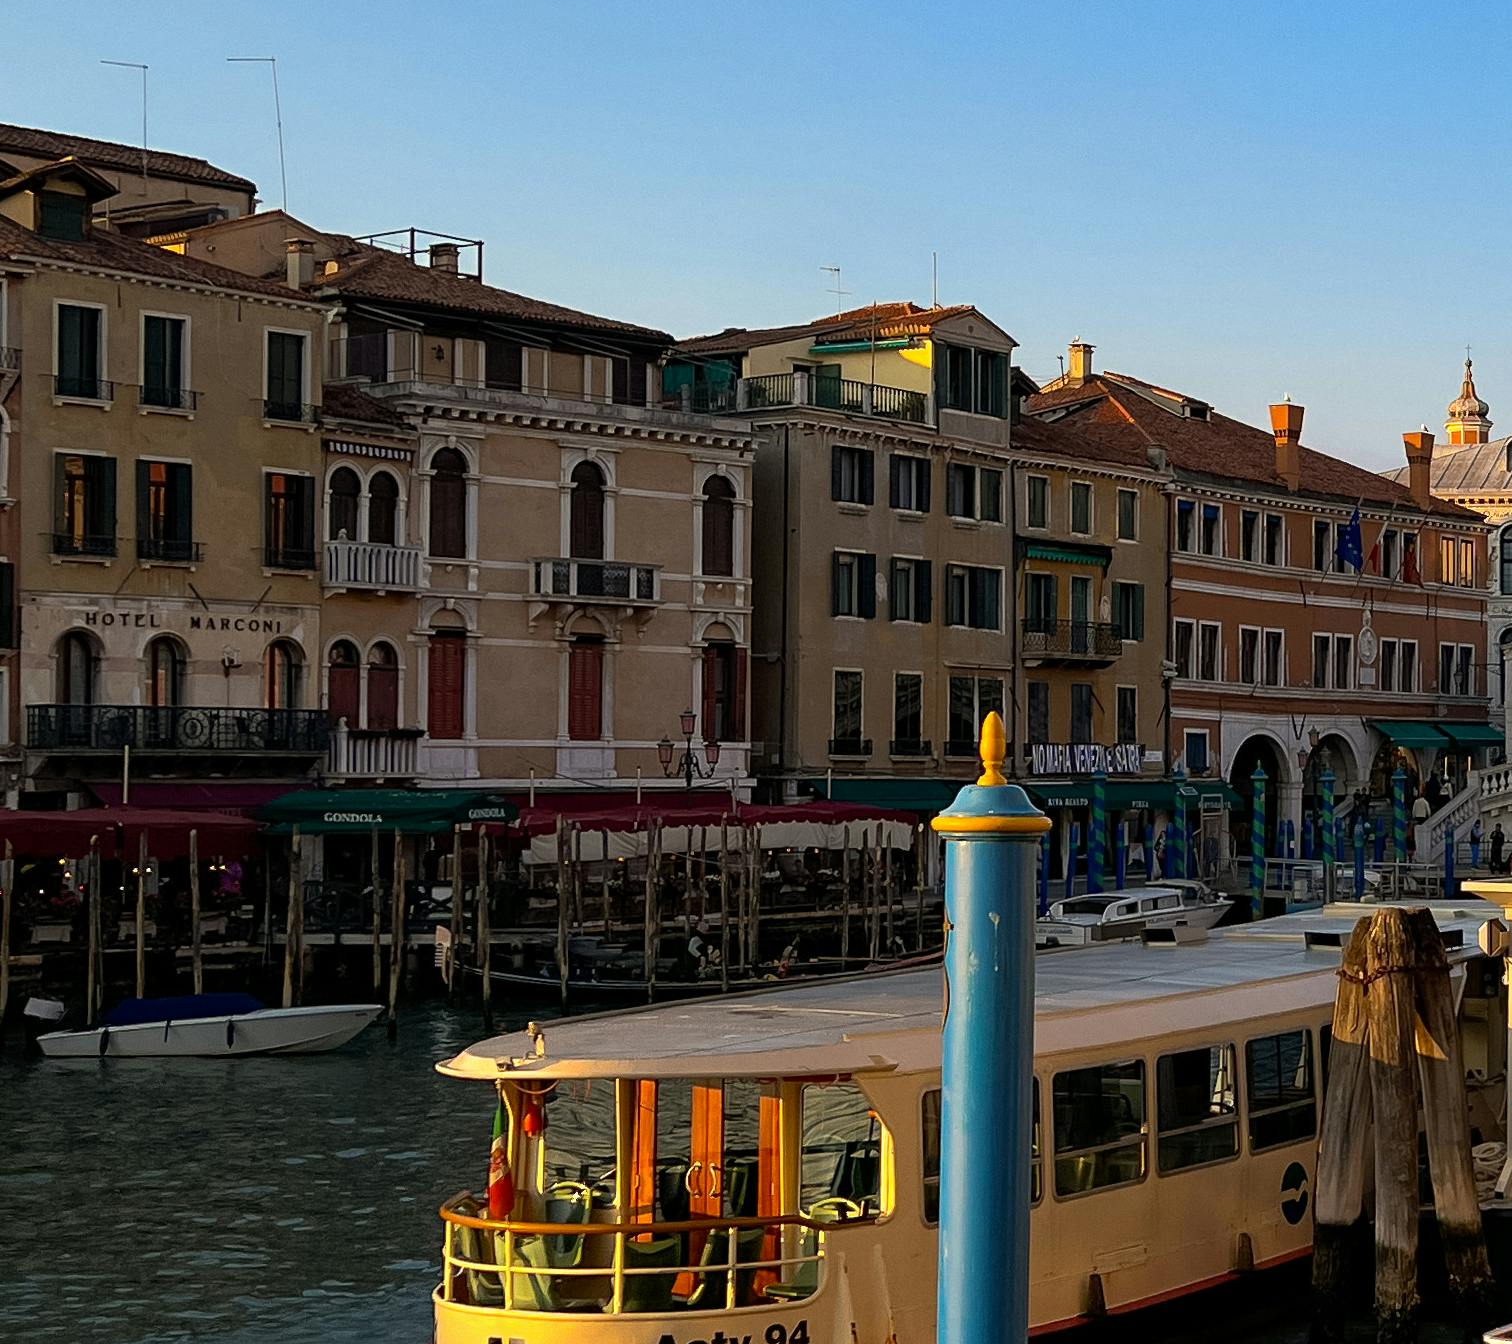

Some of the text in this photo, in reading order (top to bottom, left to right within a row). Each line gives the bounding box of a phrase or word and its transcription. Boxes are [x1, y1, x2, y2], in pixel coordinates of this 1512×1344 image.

[85, 612, 281, 634] HOTEL MARCONI
[1032, 744, 1045, 774] NO
[1046, 744, 1072, 774] MAFIA
[323, 812, 383, 823] GONDOLA
[468, 808, 506, 819] GONDOLA
